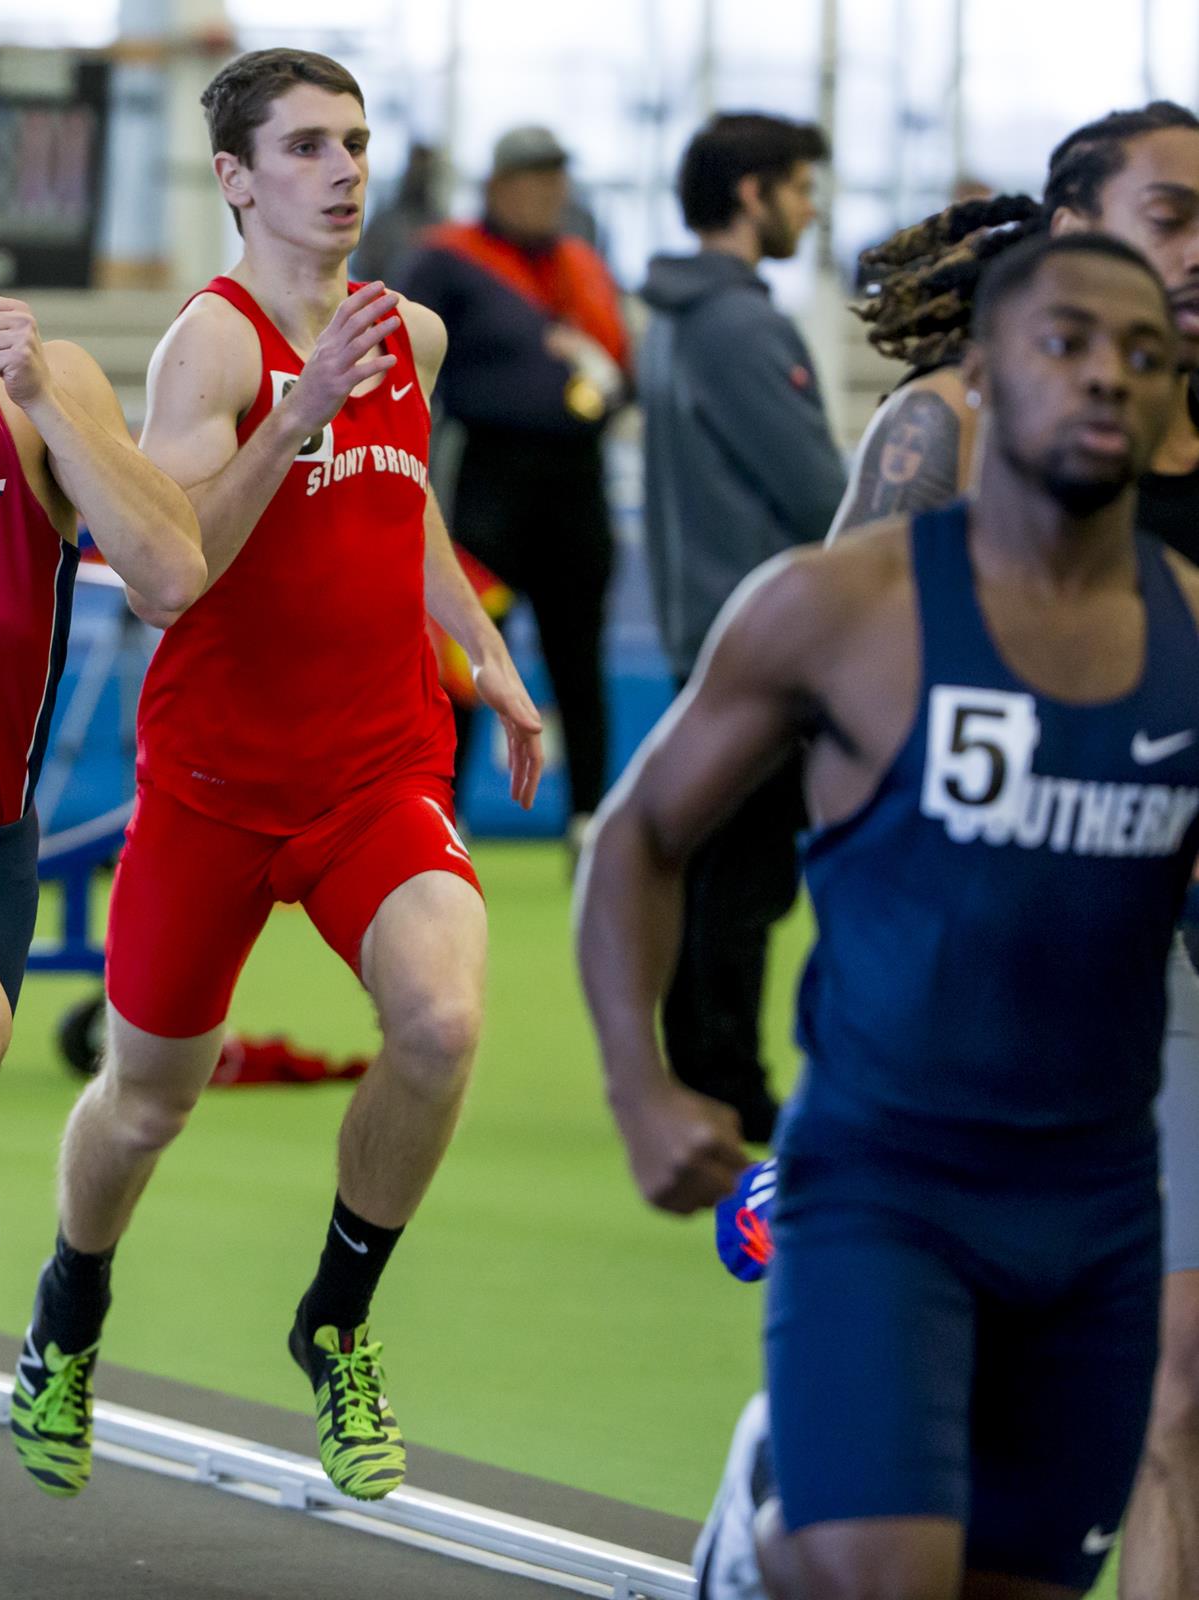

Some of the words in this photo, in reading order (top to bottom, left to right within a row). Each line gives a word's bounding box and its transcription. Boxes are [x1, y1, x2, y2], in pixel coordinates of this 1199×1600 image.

[306, 446, 367, 497] STONY
[945, 705, 1007, 806] 5
[945, 775, 1199, 858] UTHER
